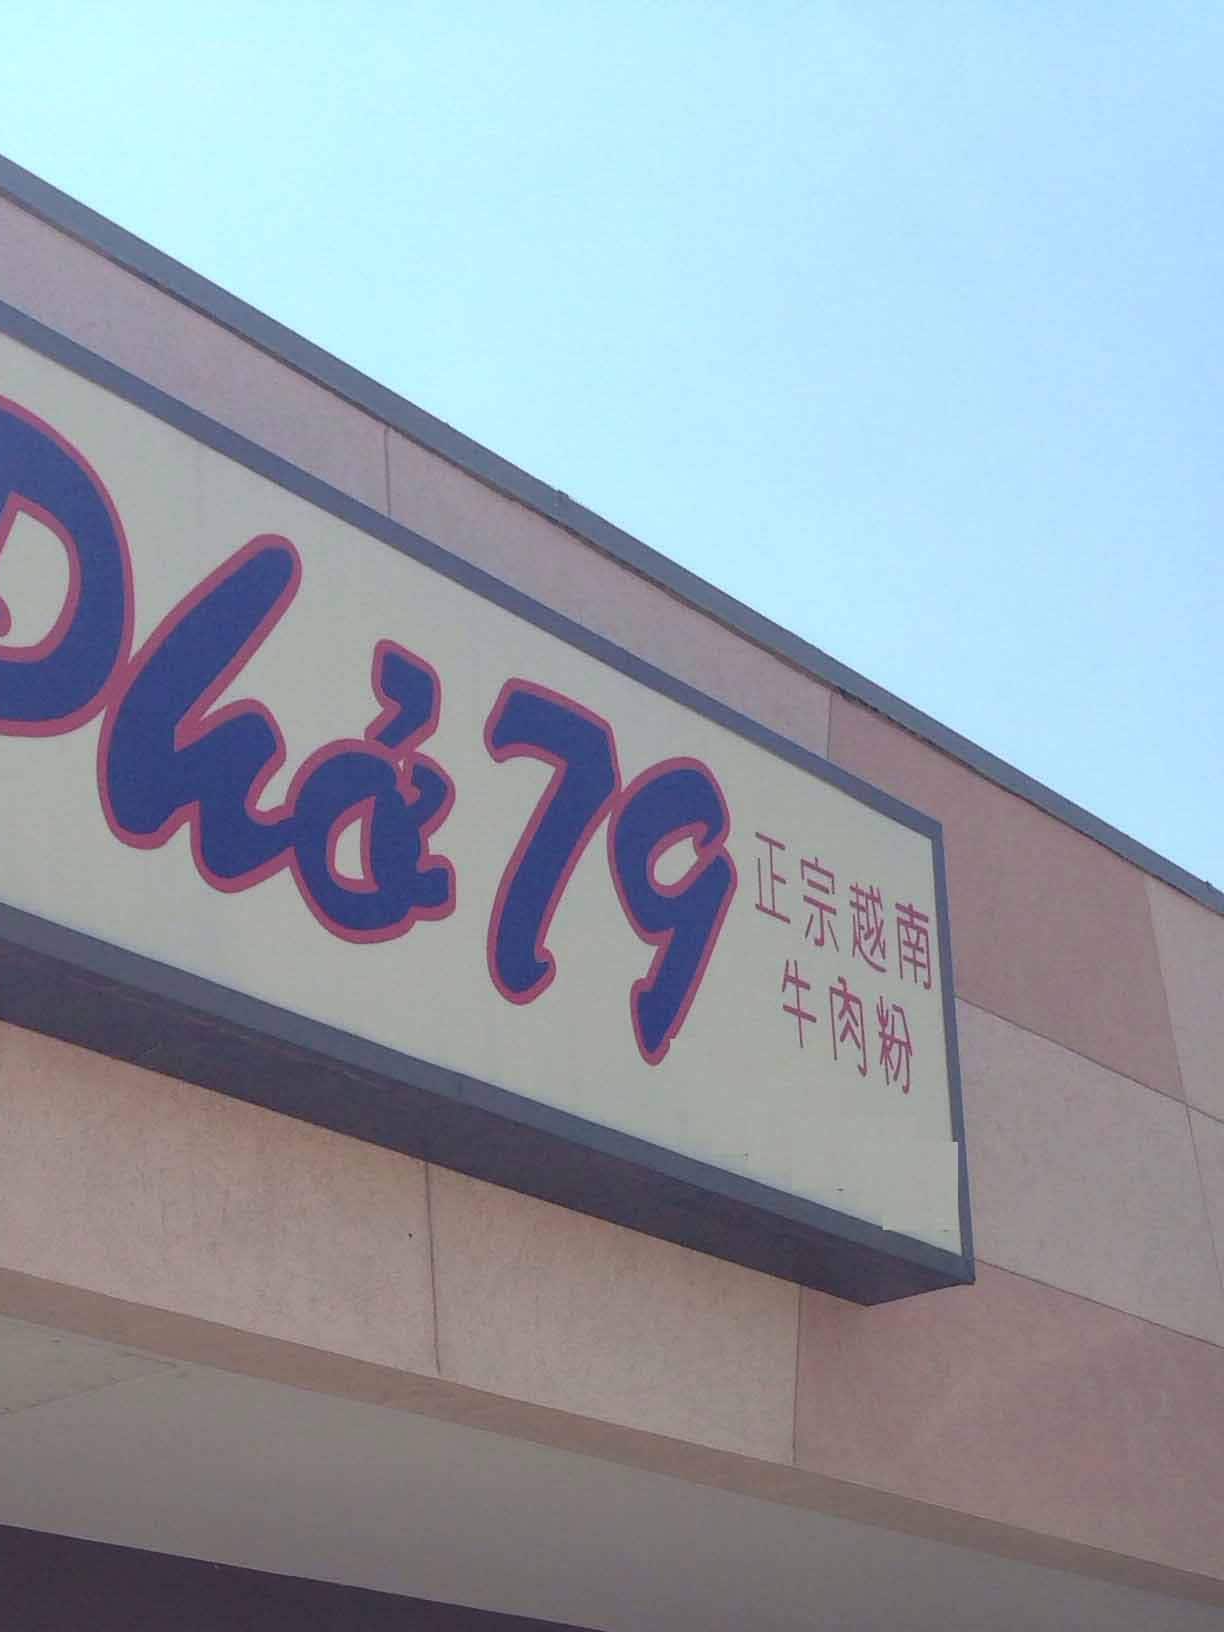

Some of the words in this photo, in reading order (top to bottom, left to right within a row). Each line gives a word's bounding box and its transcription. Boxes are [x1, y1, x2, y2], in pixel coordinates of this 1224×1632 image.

[483, 677, 738, 1067] 79
[754, 831, 933, 991] 正宗越南
[781, 959, 913, 1095] 牛肉粉
